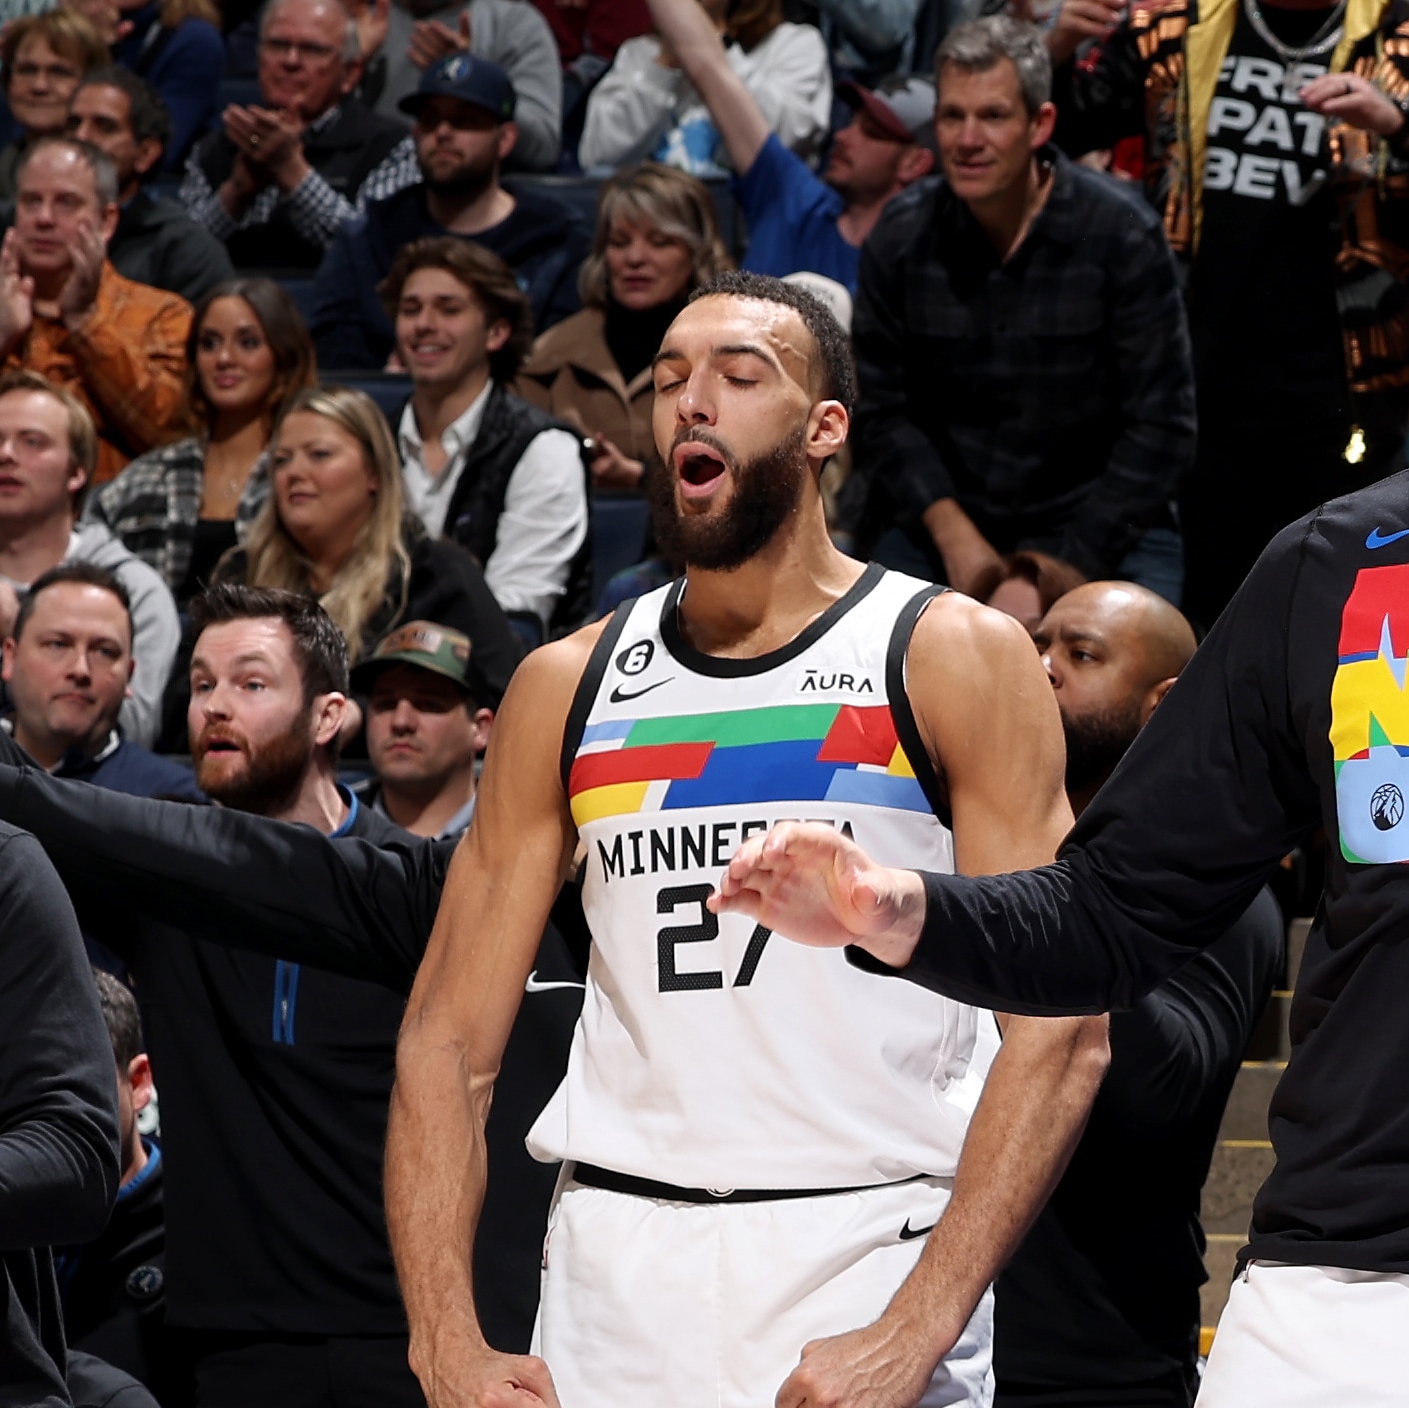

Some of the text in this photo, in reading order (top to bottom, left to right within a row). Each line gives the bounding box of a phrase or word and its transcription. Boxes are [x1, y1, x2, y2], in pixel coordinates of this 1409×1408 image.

[1218, 55, 1328, 104] FRE
[1207, 96, 1325, 157] PAT
[1203, 146, 1326, 206] BEV
[624, 644, 648, 673] 6
[597, 820, 856, 883] MINNE
